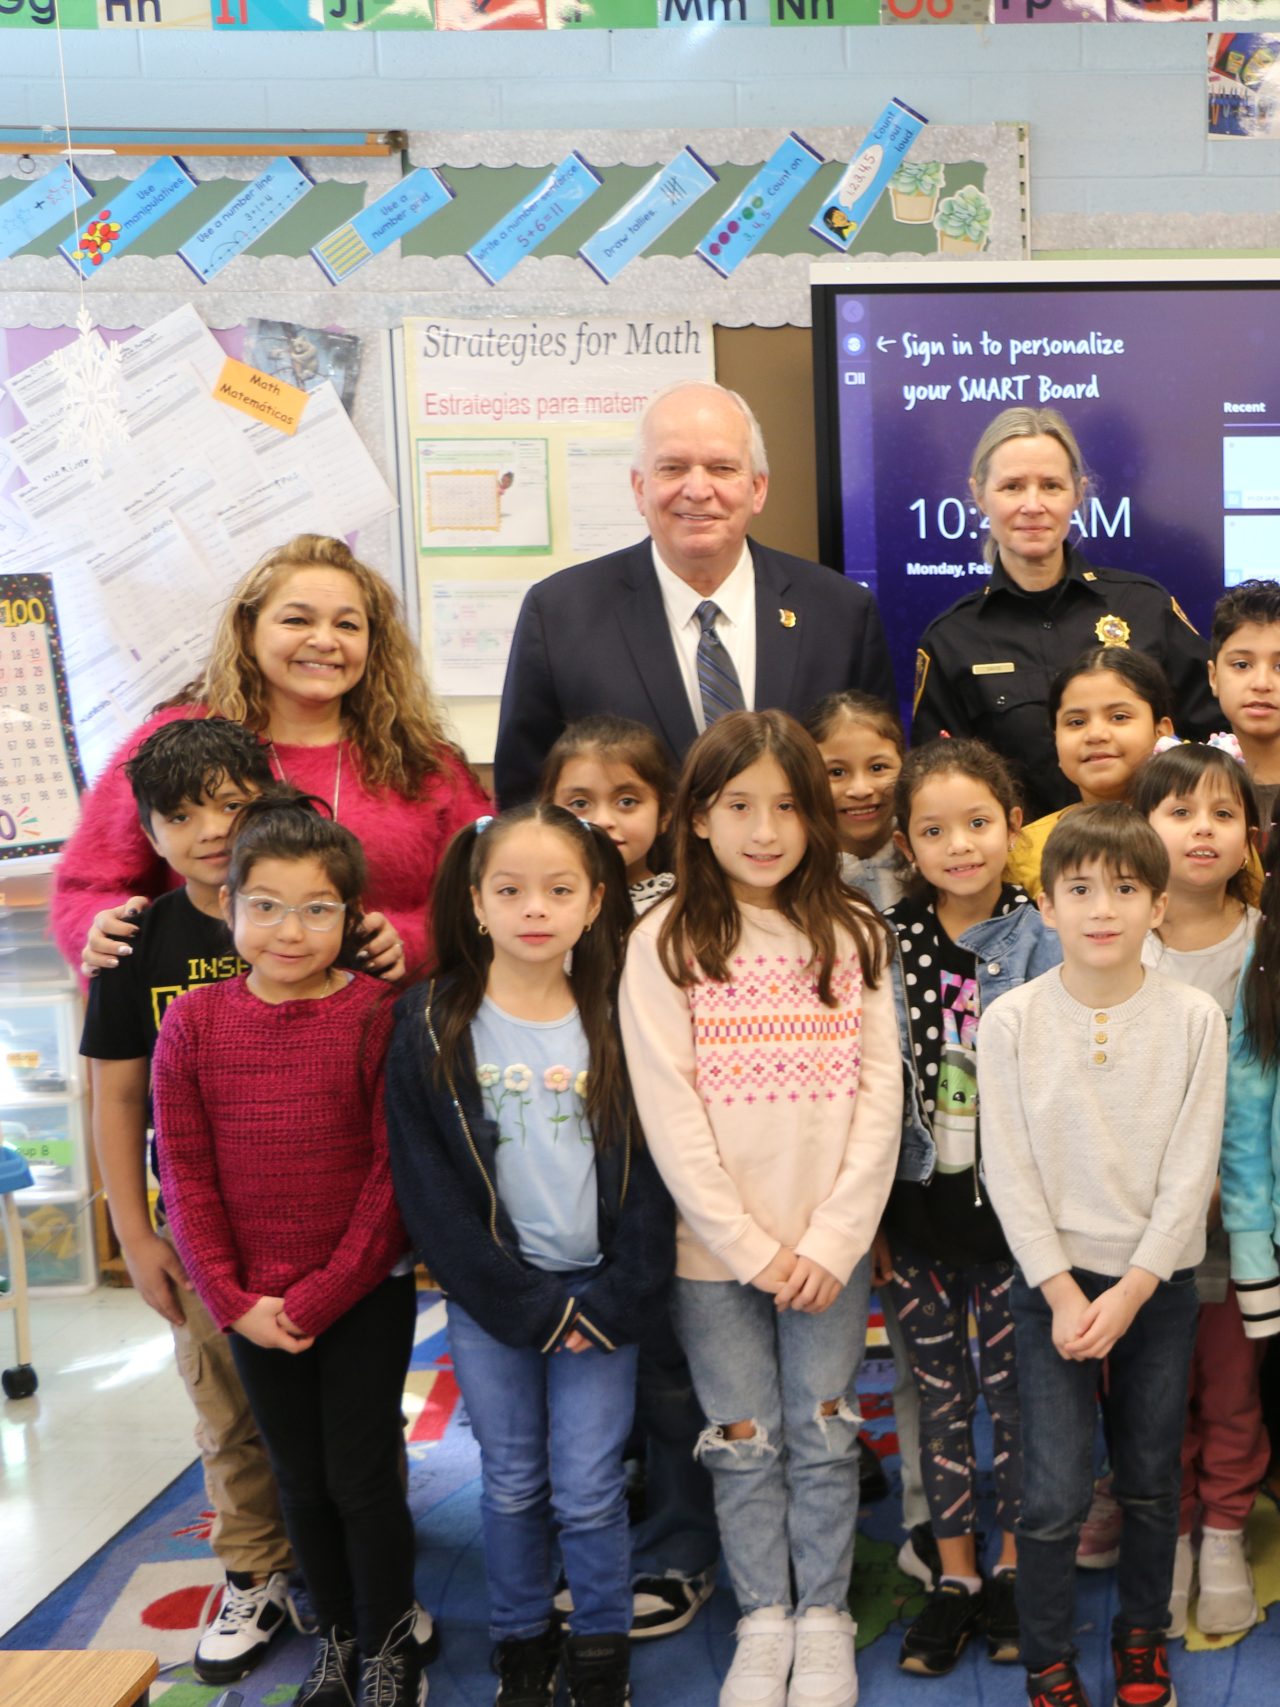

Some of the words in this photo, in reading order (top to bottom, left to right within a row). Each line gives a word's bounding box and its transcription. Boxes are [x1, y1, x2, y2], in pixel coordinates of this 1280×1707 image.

[872, 111, 895, 140] Count
[889, 124, 902, 142] out
[136, 184, 156, 200] Use
[767, 171, 794, 197] Count
[196, 225, 214, 243] Use
[222, 192, 256, 220] number
[380, 200, 400, 216] Use
[400, 195, 408, 204] a
[371, 209, 407, 239] number
[476, 236, 500, 260] Write
[507, 200, 538, 231] number
[603, 233, 630, 258] Draw
[423, 323, 566, 365] Strategies
[571, 322, 616, 365] for
[625, 320, 701, 355] Math
[902, 332, 945, 367] Sign
[952, 332, 973, 356] in
[980, 331, 1002, 354] to
[1010, 331, 1124, 364] personalize
[249, 373, 281, 396] Math
[903, 380, 951, 411] your
[959, 374, 1031, 402] SMART
[1039, 374, 1099, 402] Board
[219, 382, 295, 426] Matemáticas
[425, 392, 531, 421] Estrategias
[537, 397, 579, 420] para
[1223, 402, 1265, 413] Recent
[907, 562, 966, 577] Monday,
[4, 598, 46, 627] 100
